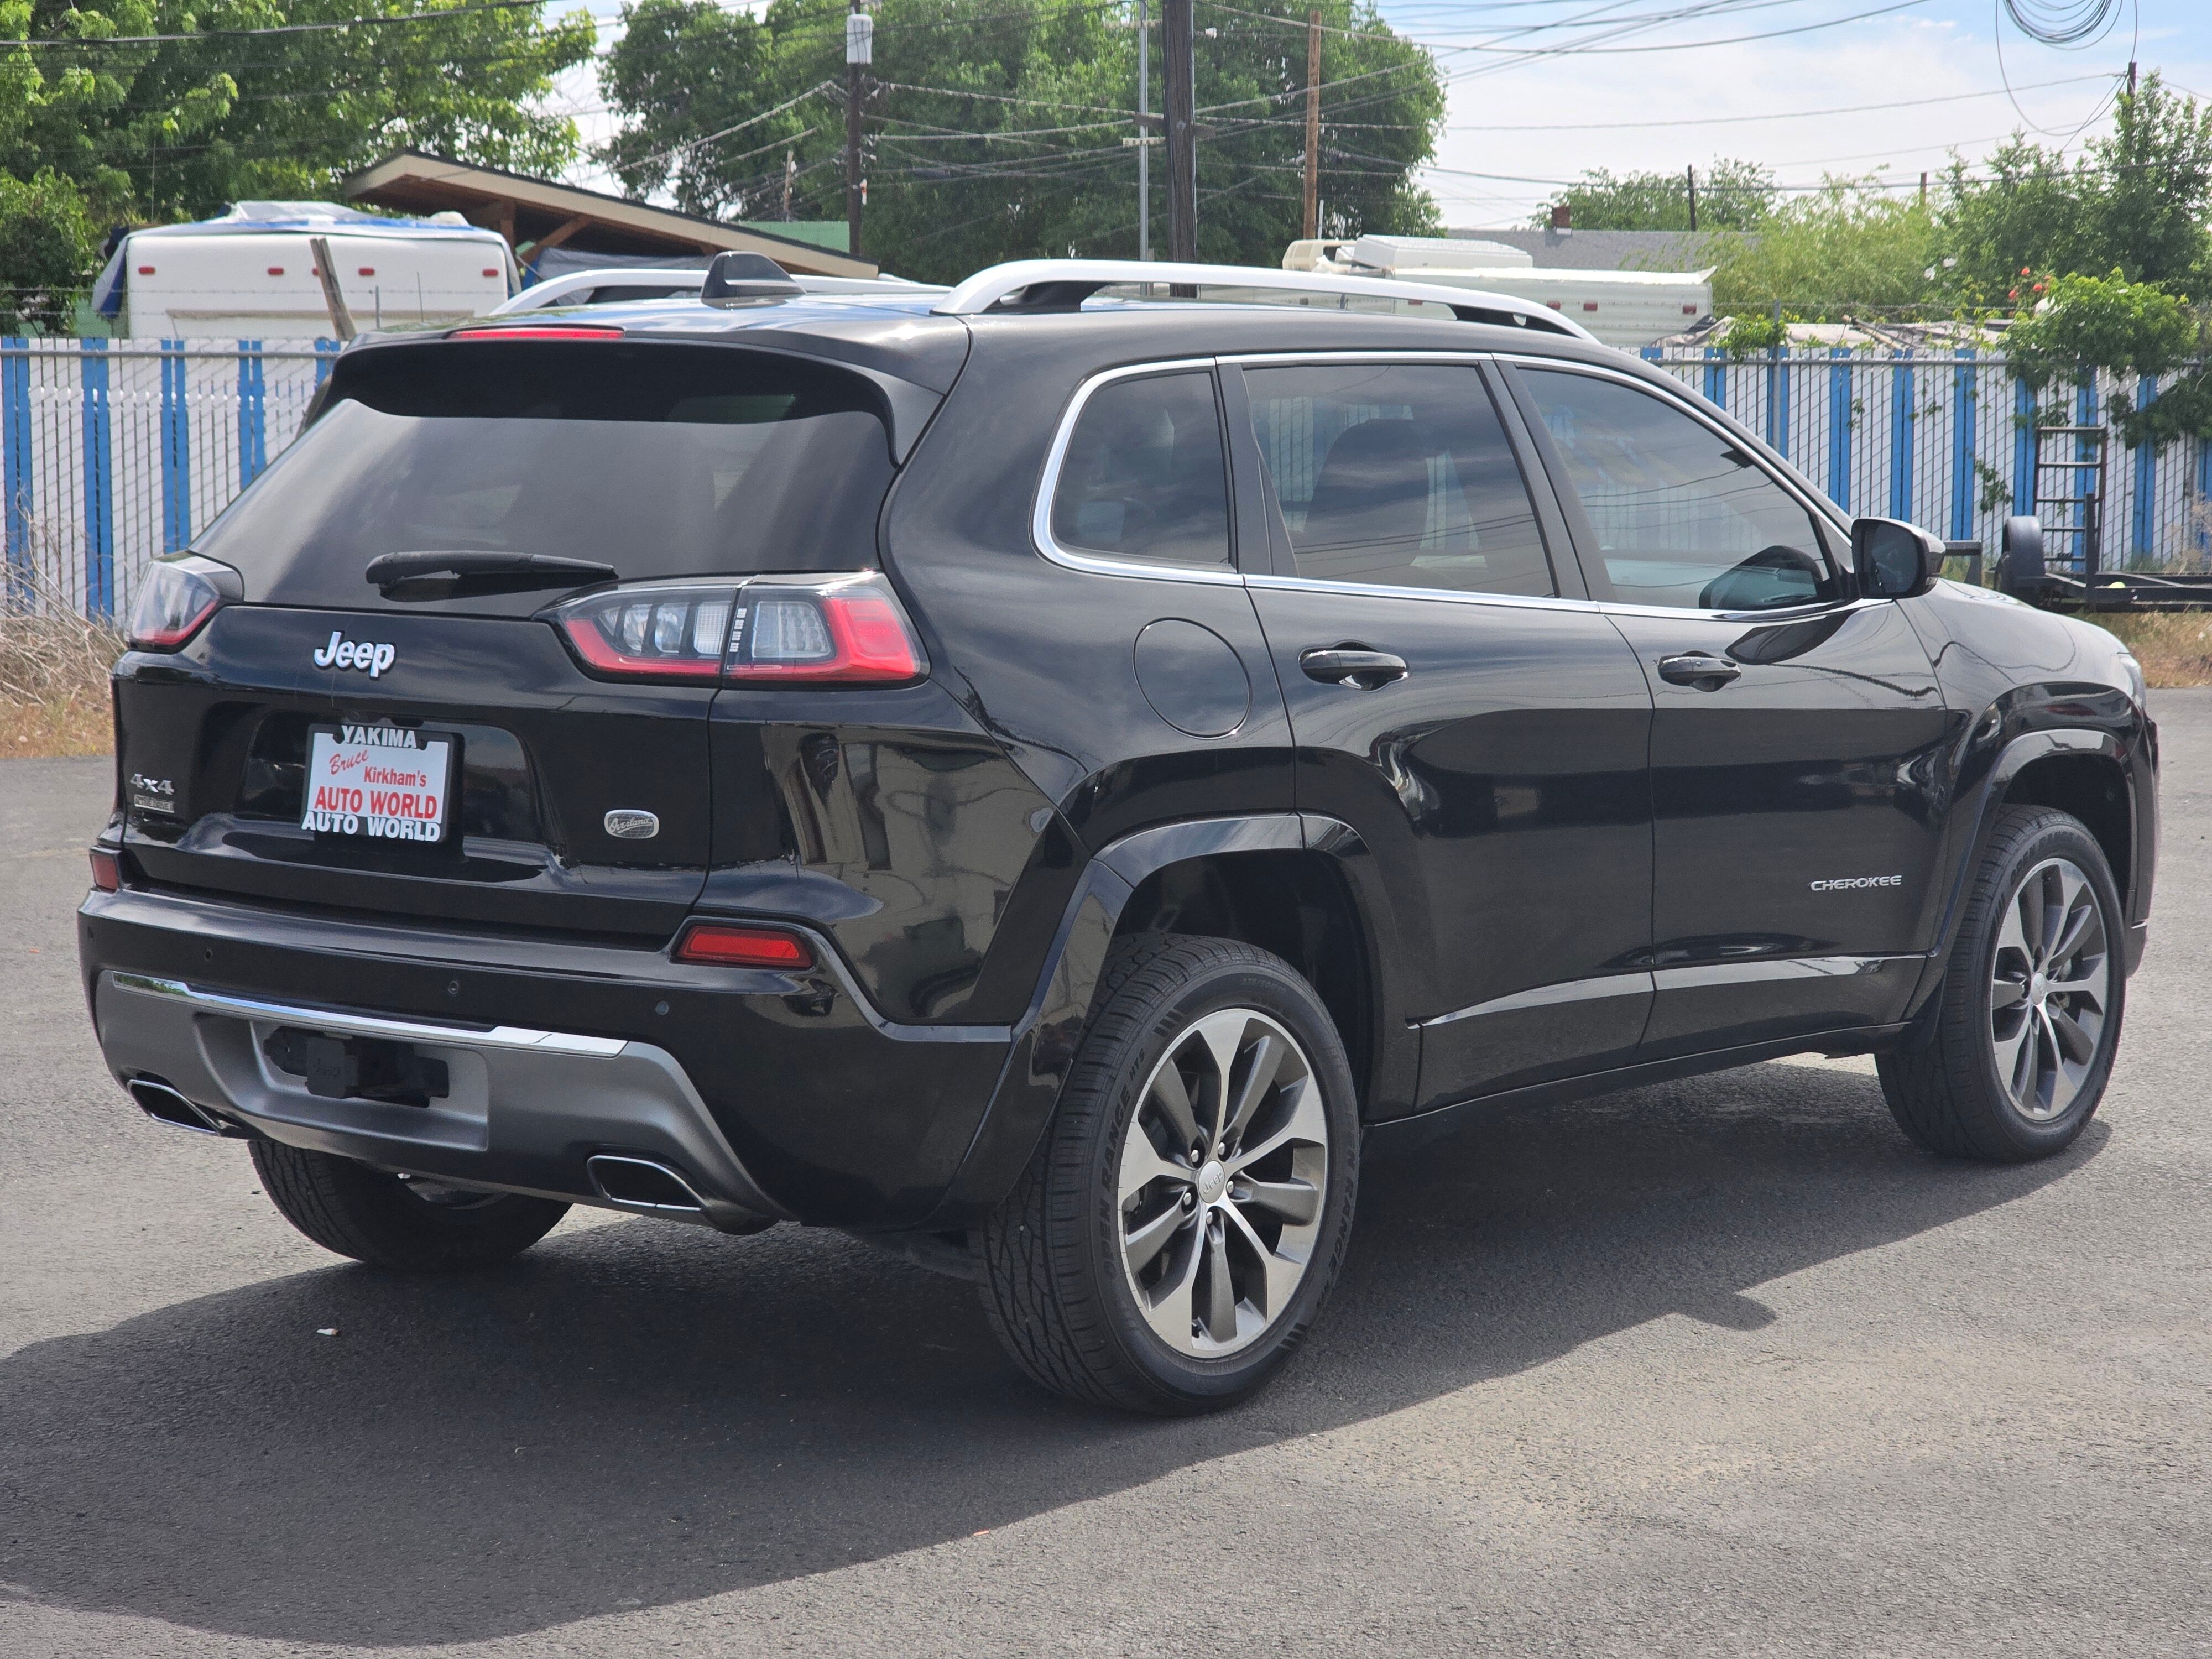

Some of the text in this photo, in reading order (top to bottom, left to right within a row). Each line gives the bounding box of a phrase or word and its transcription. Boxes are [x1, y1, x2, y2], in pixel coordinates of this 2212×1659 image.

[314, 632, 395, 678] Jeep
[341, 725, 417, 748] YAKIMA
[329, 749, 369, 775] Bruce
[363, 766, 427, 787] Kirkham's
[314, 786, 437, 819] AUTO WORLD
[301, 811, 440, 842] AUTO WORLD
[1811, 875, 1902, 891] CHEROKEE
[1100, 1083, 1130, 1193] RANGE
[1203, 1172, 1223, 1194] Jeep
